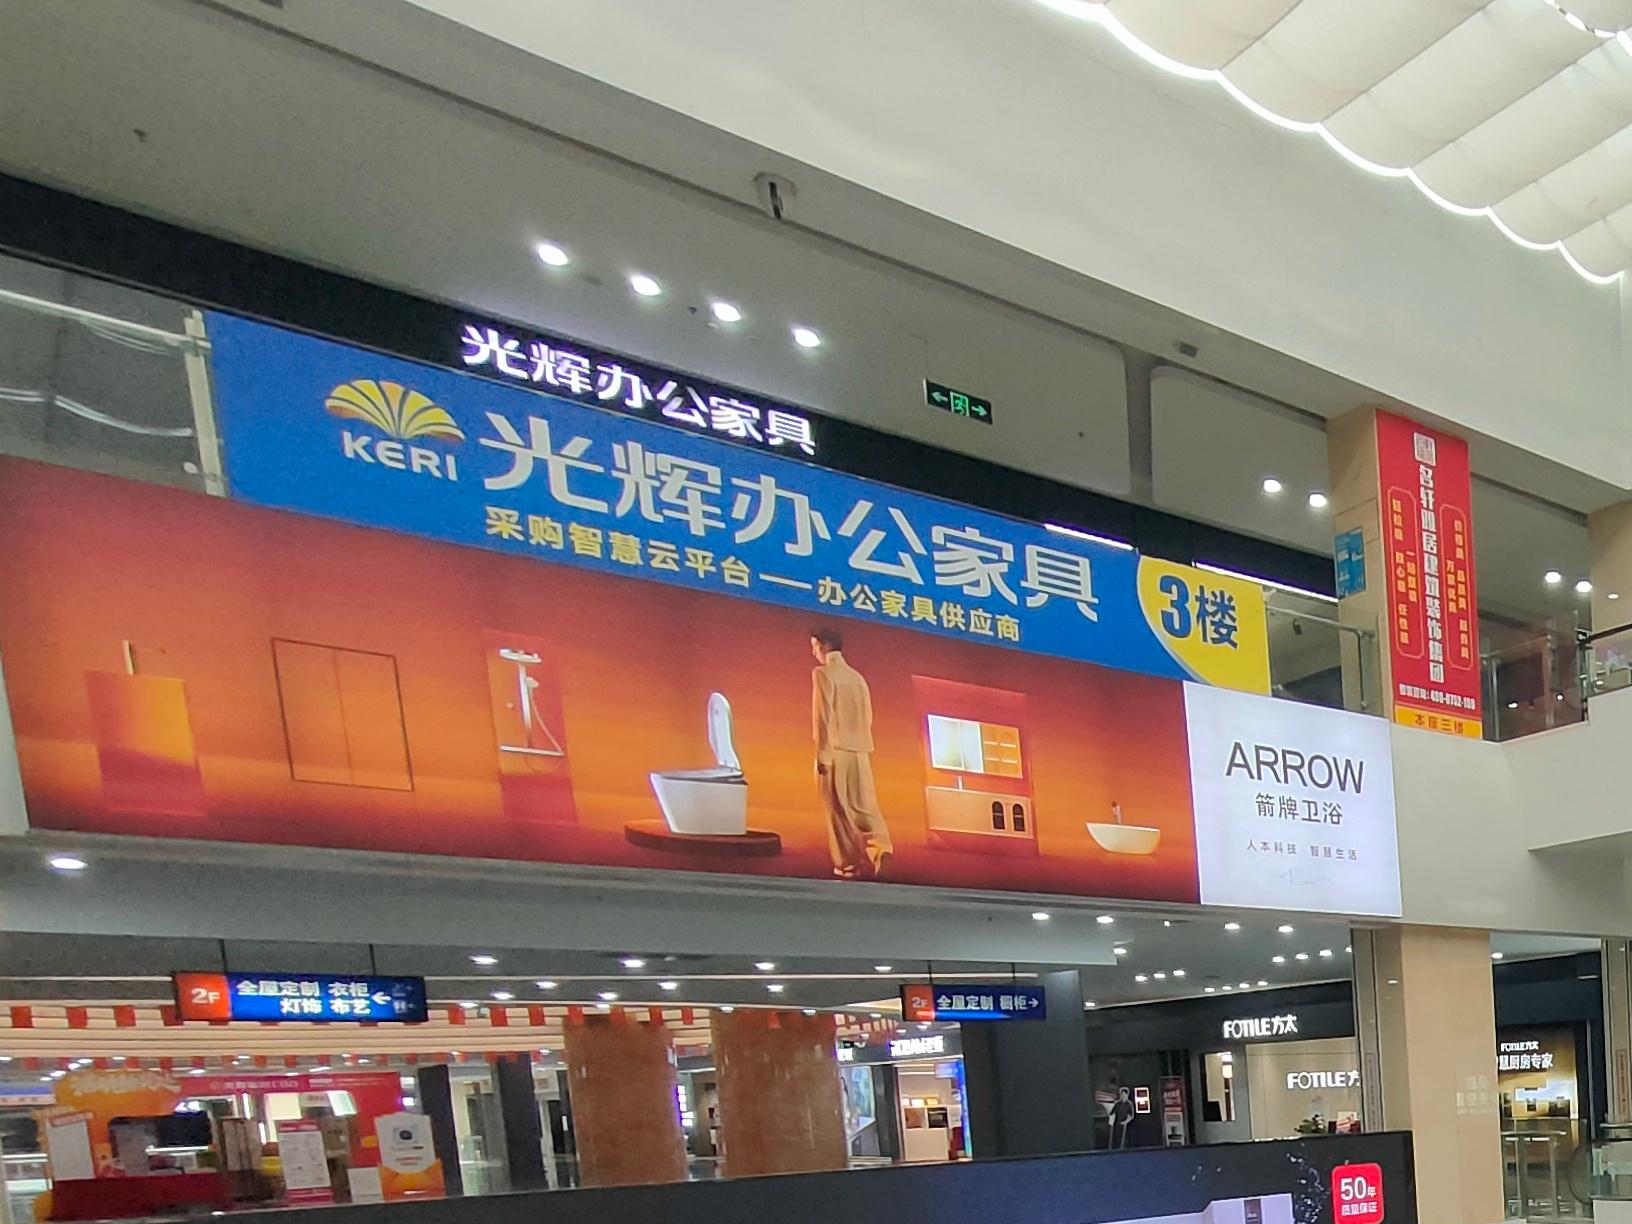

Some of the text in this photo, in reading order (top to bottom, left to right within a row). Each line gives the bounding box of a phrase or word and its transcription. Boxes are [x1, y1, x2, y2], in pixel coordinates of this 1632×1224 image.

[460, 324, 817, 456] 光辉办公家具
[342, 431, 458, 481] KERI
[478, 412, 1099, 622] 光辉办公家具
[1158, 575, 1239, 650] 3楼
[1225, 741, 1364, 794] ARROW
[1256, 792, 1343, 825] 箭牌卫浴
[190, 987, 219, 1004] 2F
[236, 980, 370, 998] 全屋定制 衣柜
[280, 998, 372, 1015] 灯饰 布艺
[912, 997, 928, 1009] 2F
[937, 995, 993, 1010] 全屋定制
[1497, 1053, 1554, 1071] 慧厨房专家
